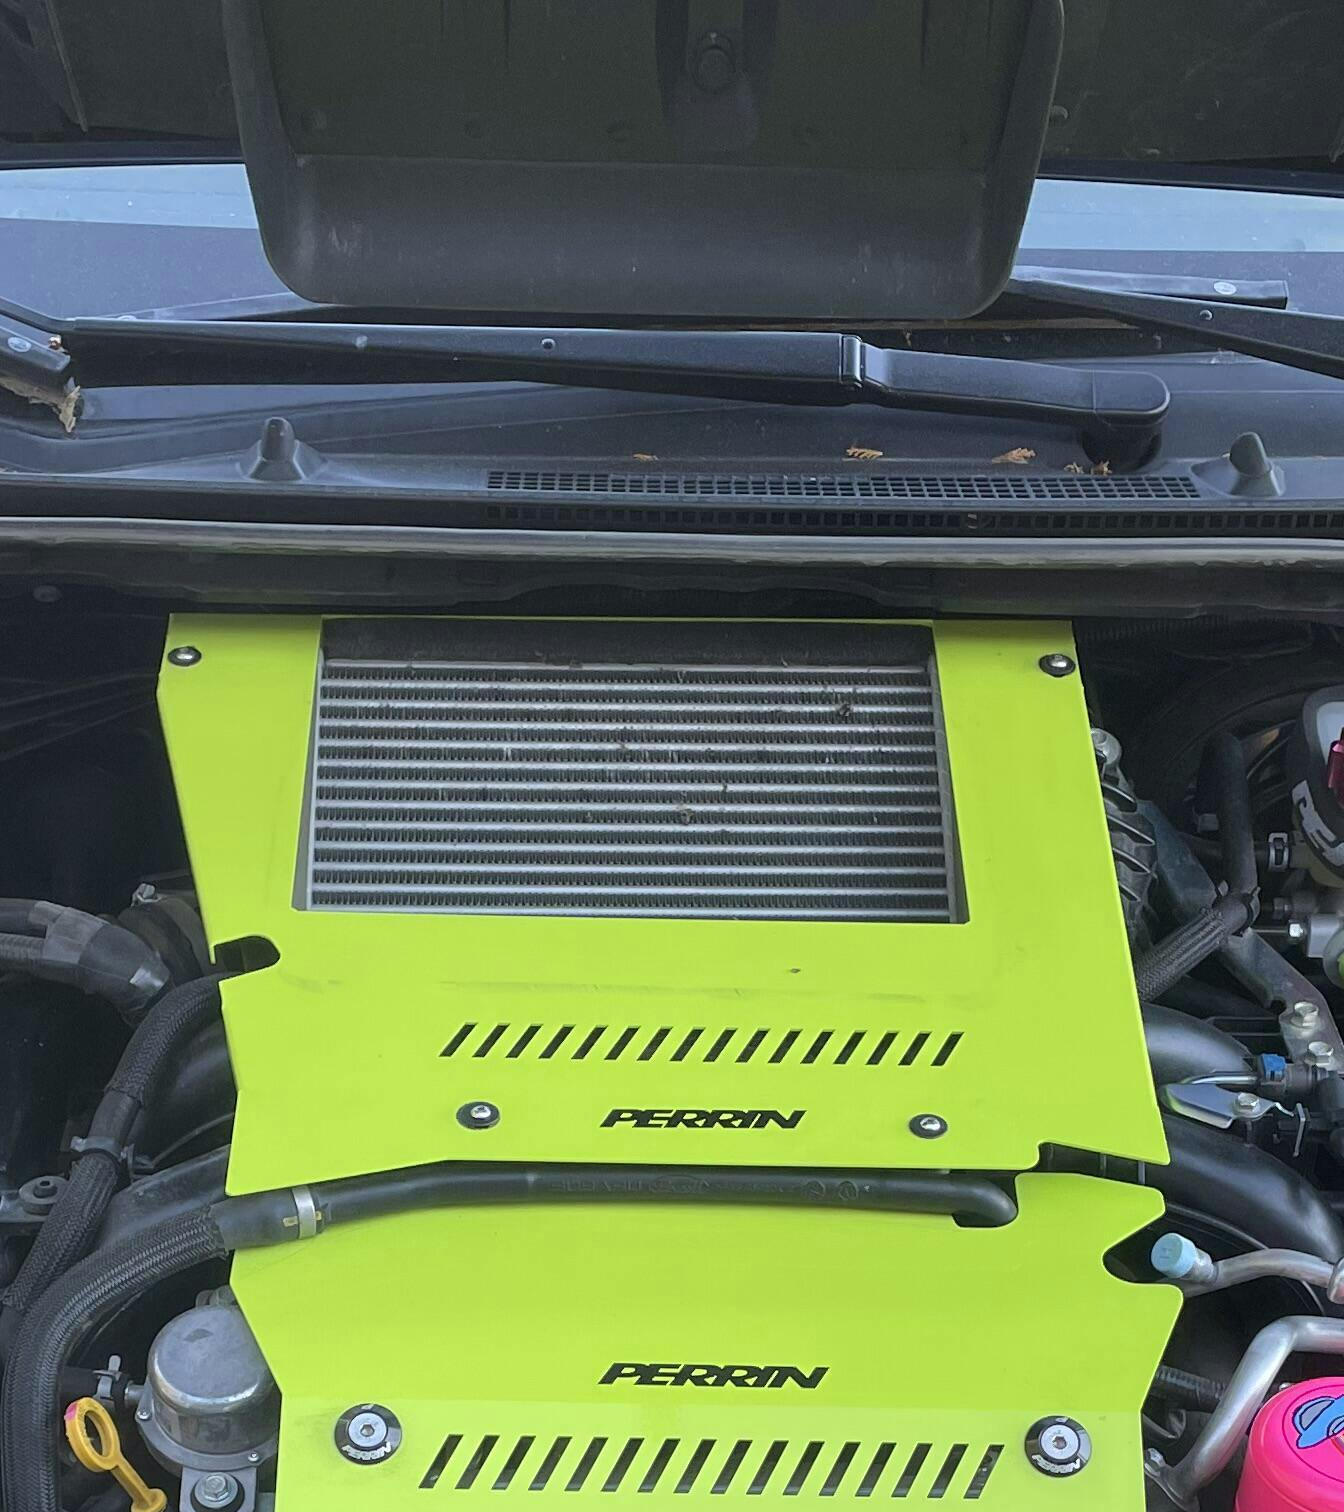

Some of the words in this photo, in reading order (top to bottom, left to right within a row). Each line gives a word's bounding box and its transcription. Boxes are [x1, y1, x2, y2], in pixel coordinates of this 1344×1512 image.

[599, 1109, 806, 1130] PERRIN
[597, 1363, 830, 1389] PERRIN
[342, 1441, 393, 1461] PERRIN
[1031, 1455, 1081, 1474] PERRIN
